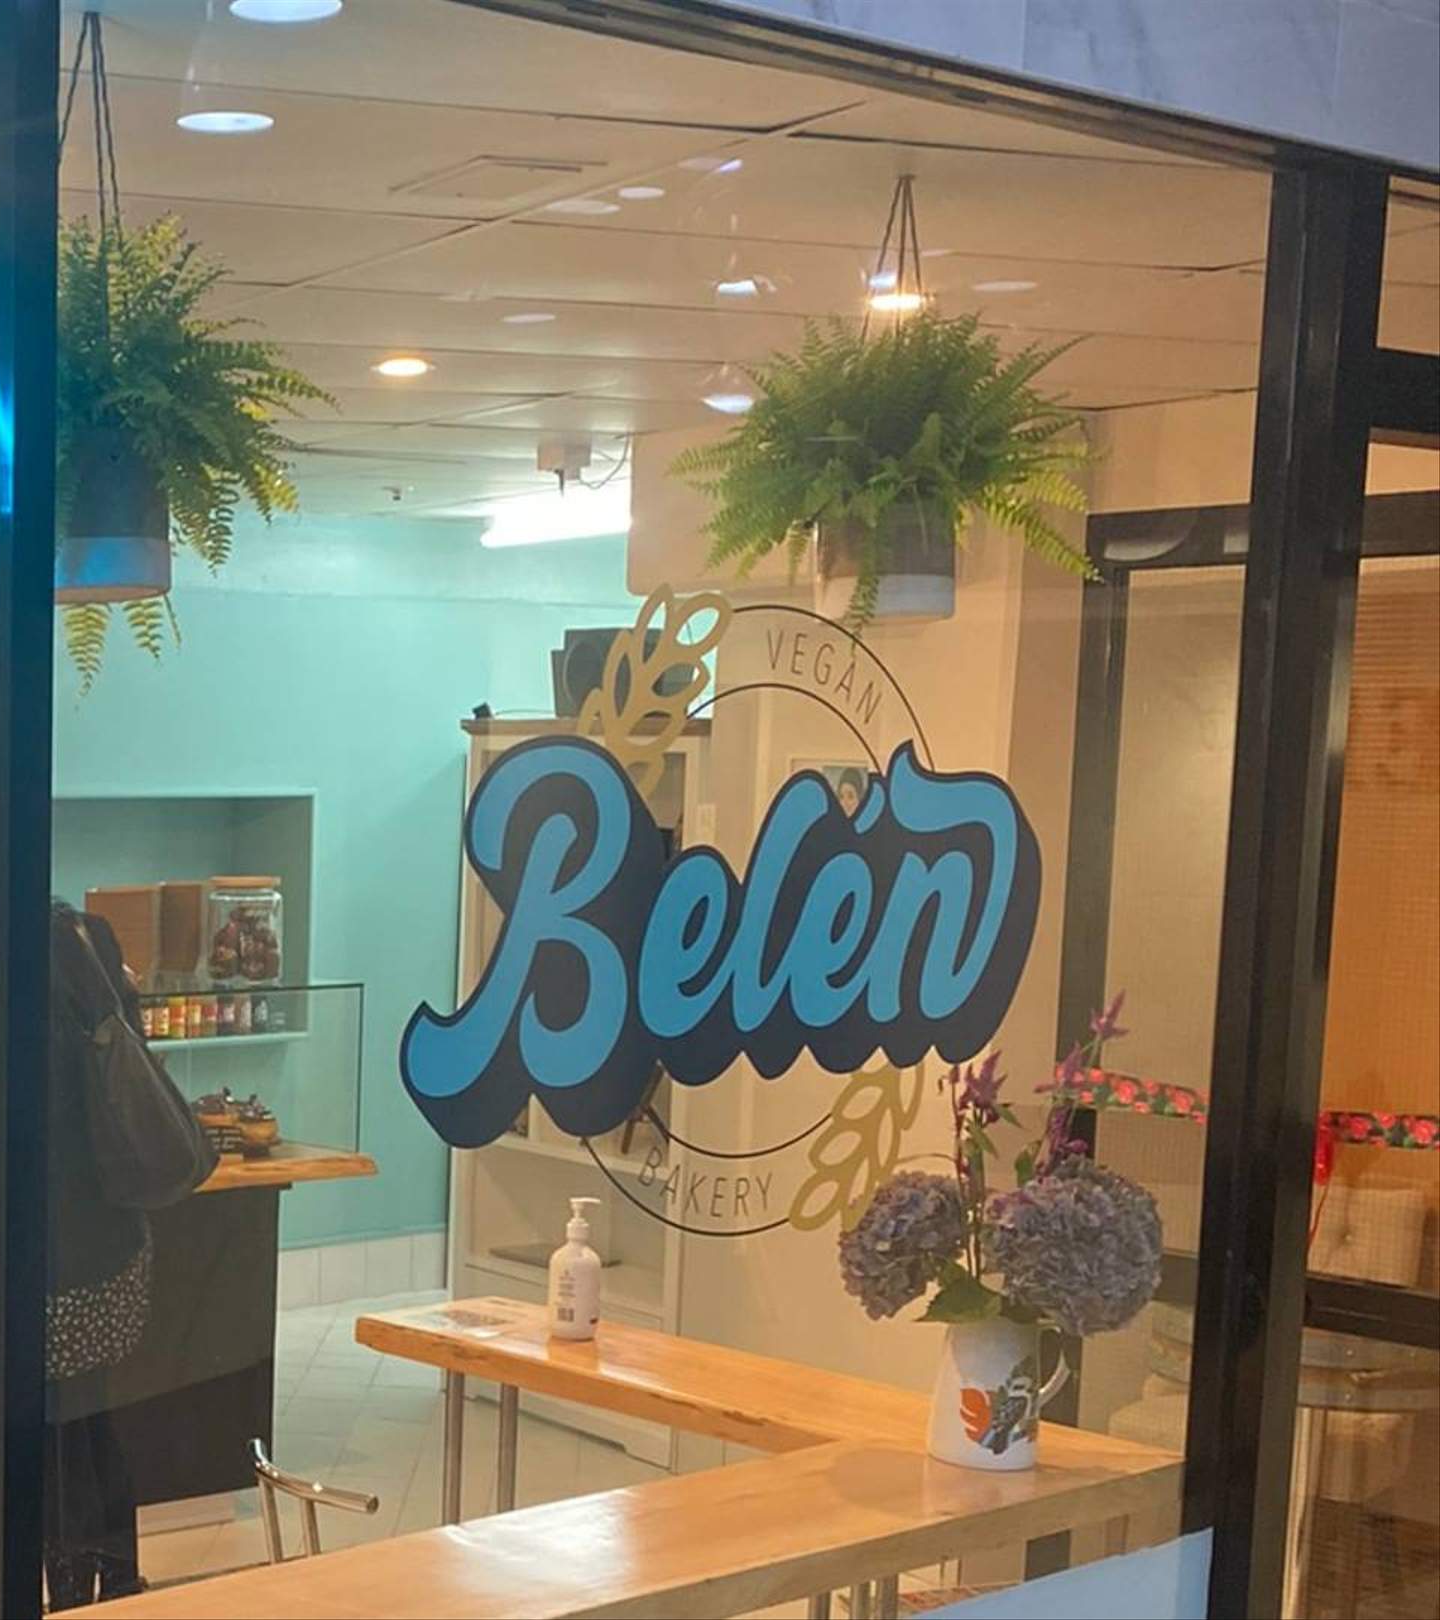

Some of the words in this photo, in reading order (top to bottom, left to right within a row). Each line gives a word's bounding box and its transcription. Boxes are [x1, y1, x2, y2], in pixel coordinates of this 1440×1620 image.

[764, 626, 883, 727] VEGAN
[399, 739, 1042, 1148] Belén
[637, 1145, 774, 1219] BAKERY
